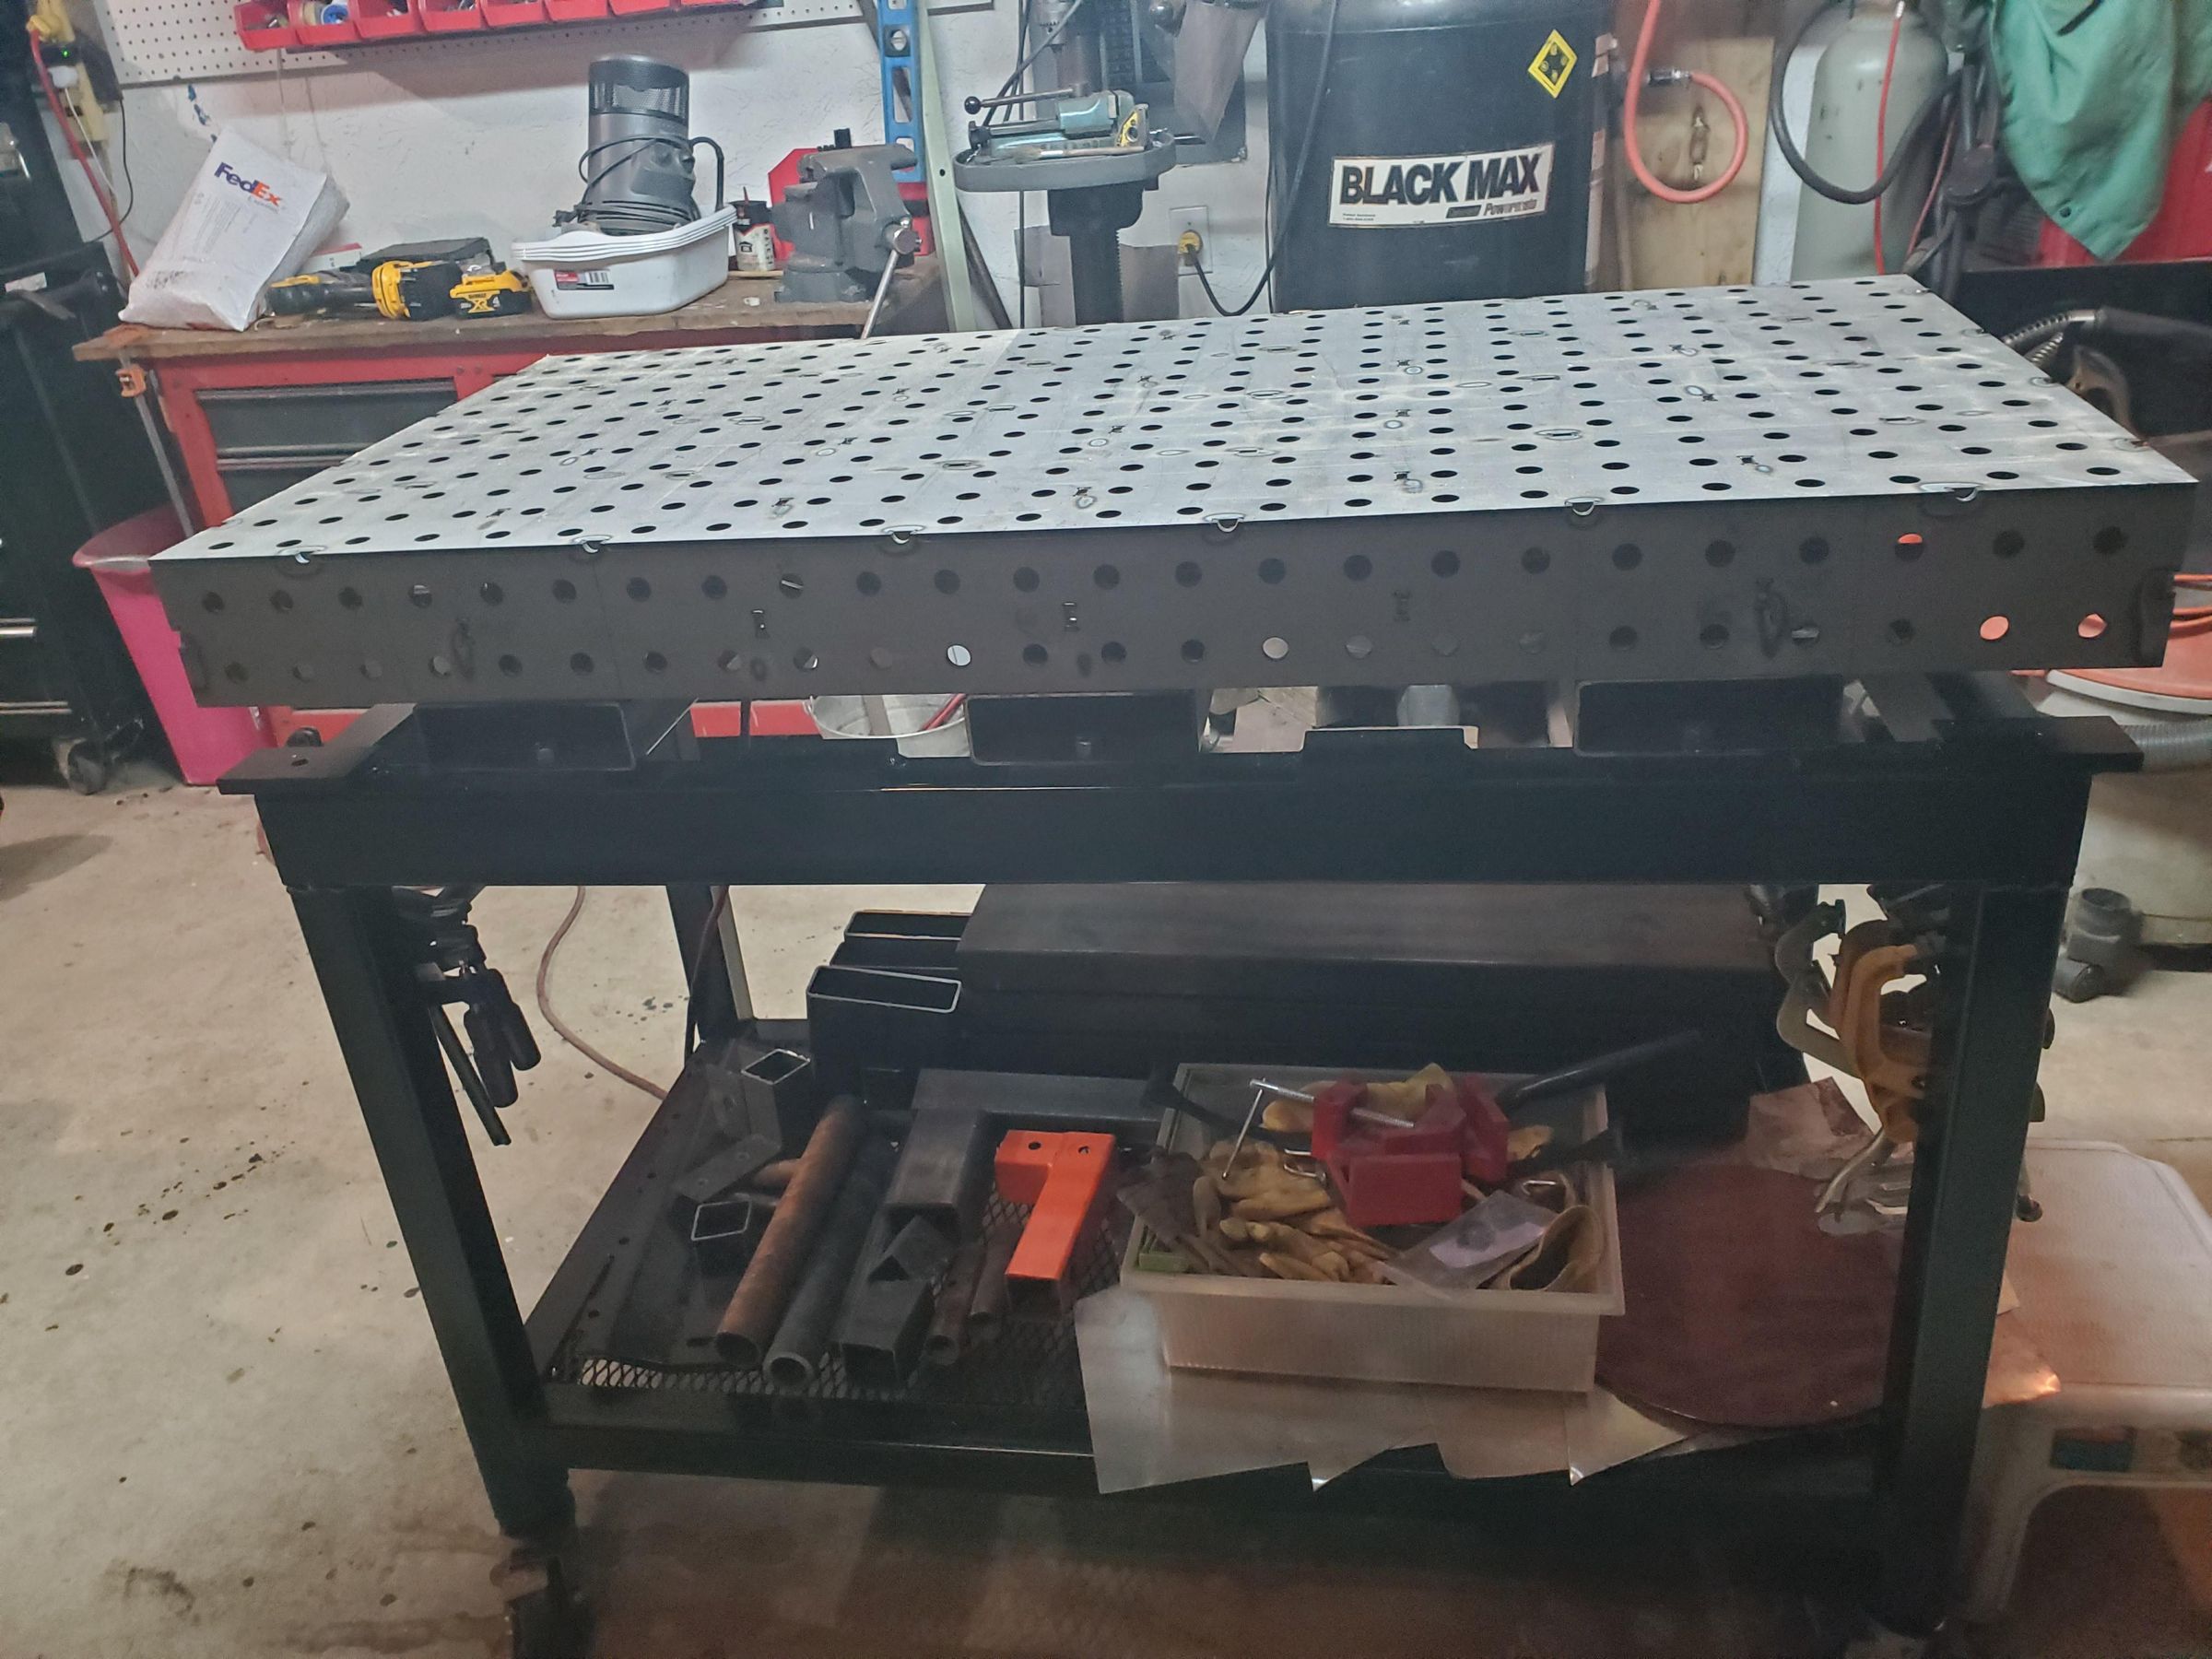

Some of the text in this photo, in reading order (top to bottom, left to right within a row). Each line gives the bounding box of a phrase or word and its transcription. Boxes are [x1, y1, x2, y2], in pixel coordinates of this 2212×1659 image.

[214, 161, 282, 207] FedEx
[1339, 153, 1543, 206] BLACK MAX
